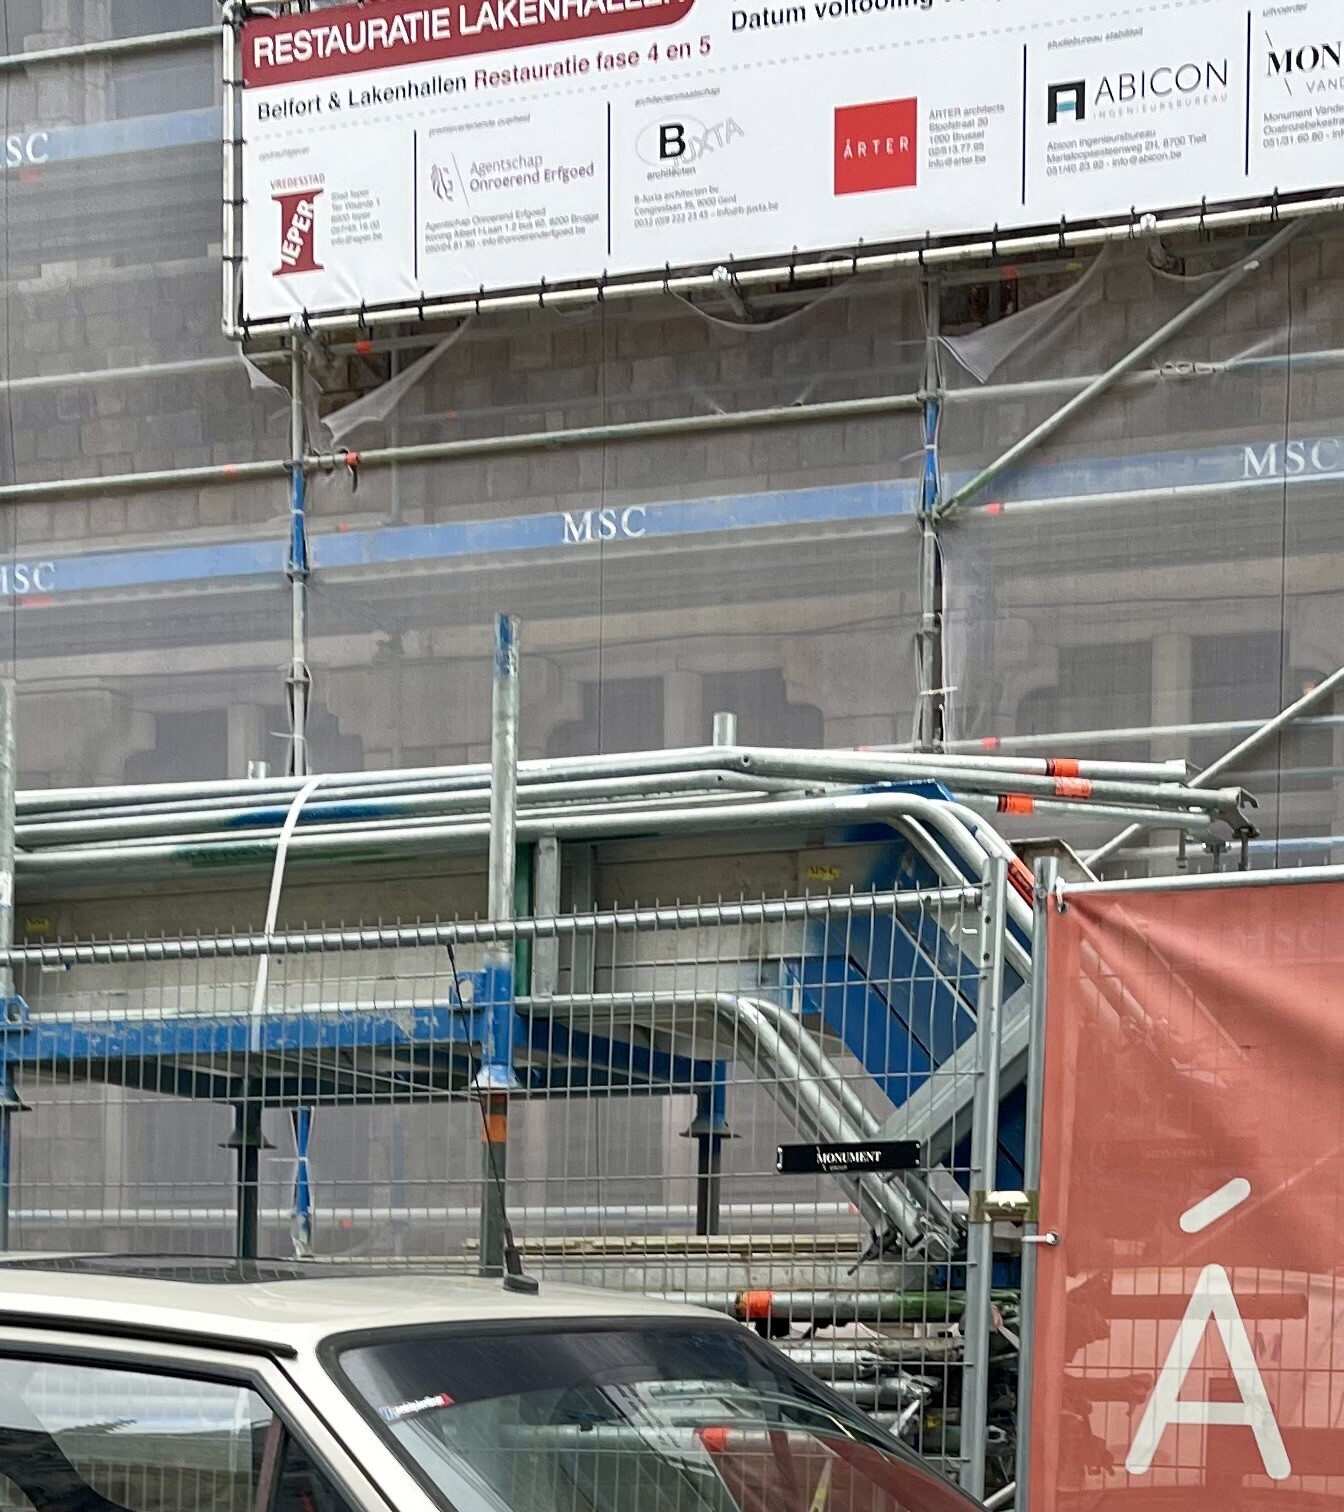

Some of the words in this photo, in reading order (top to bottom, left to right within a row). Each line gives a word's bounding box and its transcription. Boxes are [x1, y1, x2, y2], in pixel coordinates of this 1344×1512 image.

[253, 7, 451, 68] RESTAURATIE
[731, 4, 806, 32] Datum
[257, 96, 322, 121] Belfort
[328, 91, 342, 110] &
[348, 75, 467, 108] Lakenhallen
[474, 55, 590, 89] Restauratie
[596, 50, 640, 72] fase
[647, 42, 659, 63] 4
[666, 42, 691, 61] en
[699, 35, 711, 56] 5
[1094, 58, 1228, 106] ABICON
[1263, 108, 1312, 123] Monument
[659, 122, 686, 161] B
[270, 173, 325, 190] VREDESSTAD
[470, 155, 543, 178] Agentschap
[470, 169, 540, 192] Onroerend
[544, 161, 595, 184] Erfgoed
[281, 199, 314, 266] IEPER
[1242, 438, 1340, 480] MSC
[562, 504, 648, 545] MSC
[816, 1150, 883, 1163] MONUMENT
